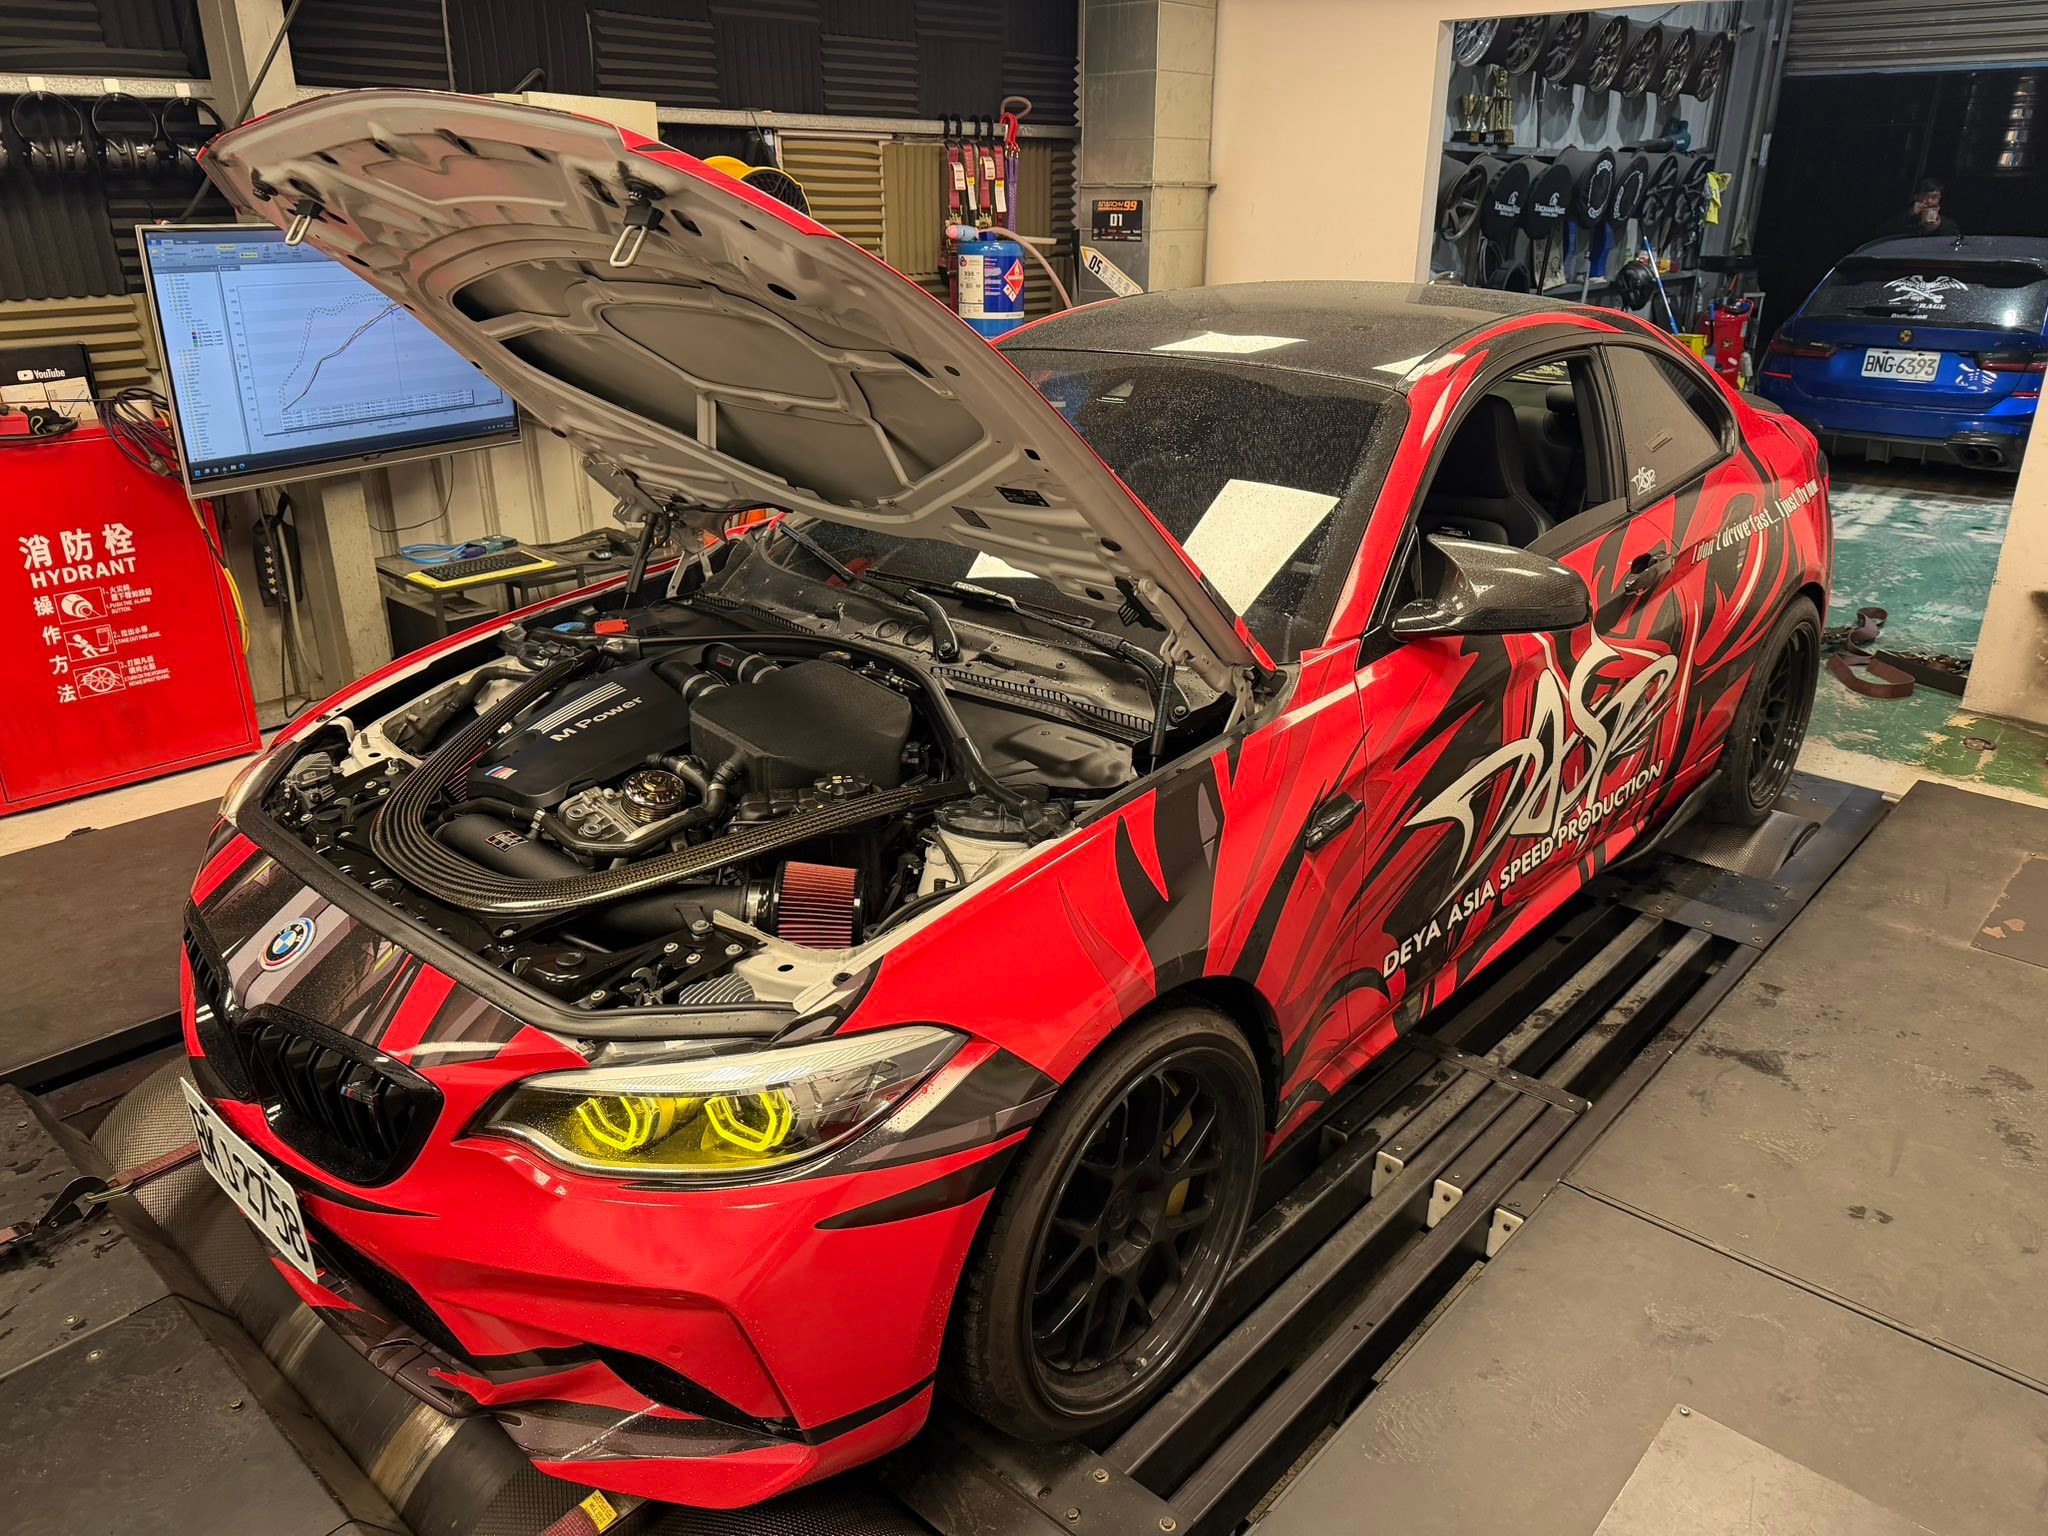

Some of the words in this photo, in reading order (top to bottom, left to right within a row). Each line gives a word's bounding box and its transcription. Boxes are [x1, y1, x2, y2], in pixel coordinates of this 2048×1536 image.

[1110, 213, 1122, 226] 01
[1088, 254, 1103, 275] 05
[33, 368, 66, 380] YouTube
[1863, 354, 1936, 377] BNG-6393
[1722, 520, 1752, 547] drive
[1779, 492, 1801, 518] just
[18, 522, 137, 571] 消防栓
[29, 556, 138, 589] HYDRANT
[32, 596, 78, 704] 操作方法
[549, 727, 578, 742] M
[574, 696, 643, 729] Power
[1382, 915, 1442, 979] DEYA
[1446, 884, 1496, 932] ASIA
[1498, 835, 1555, 892] SPEED
[1555, 758, 1665, 852] PRODUCTION
